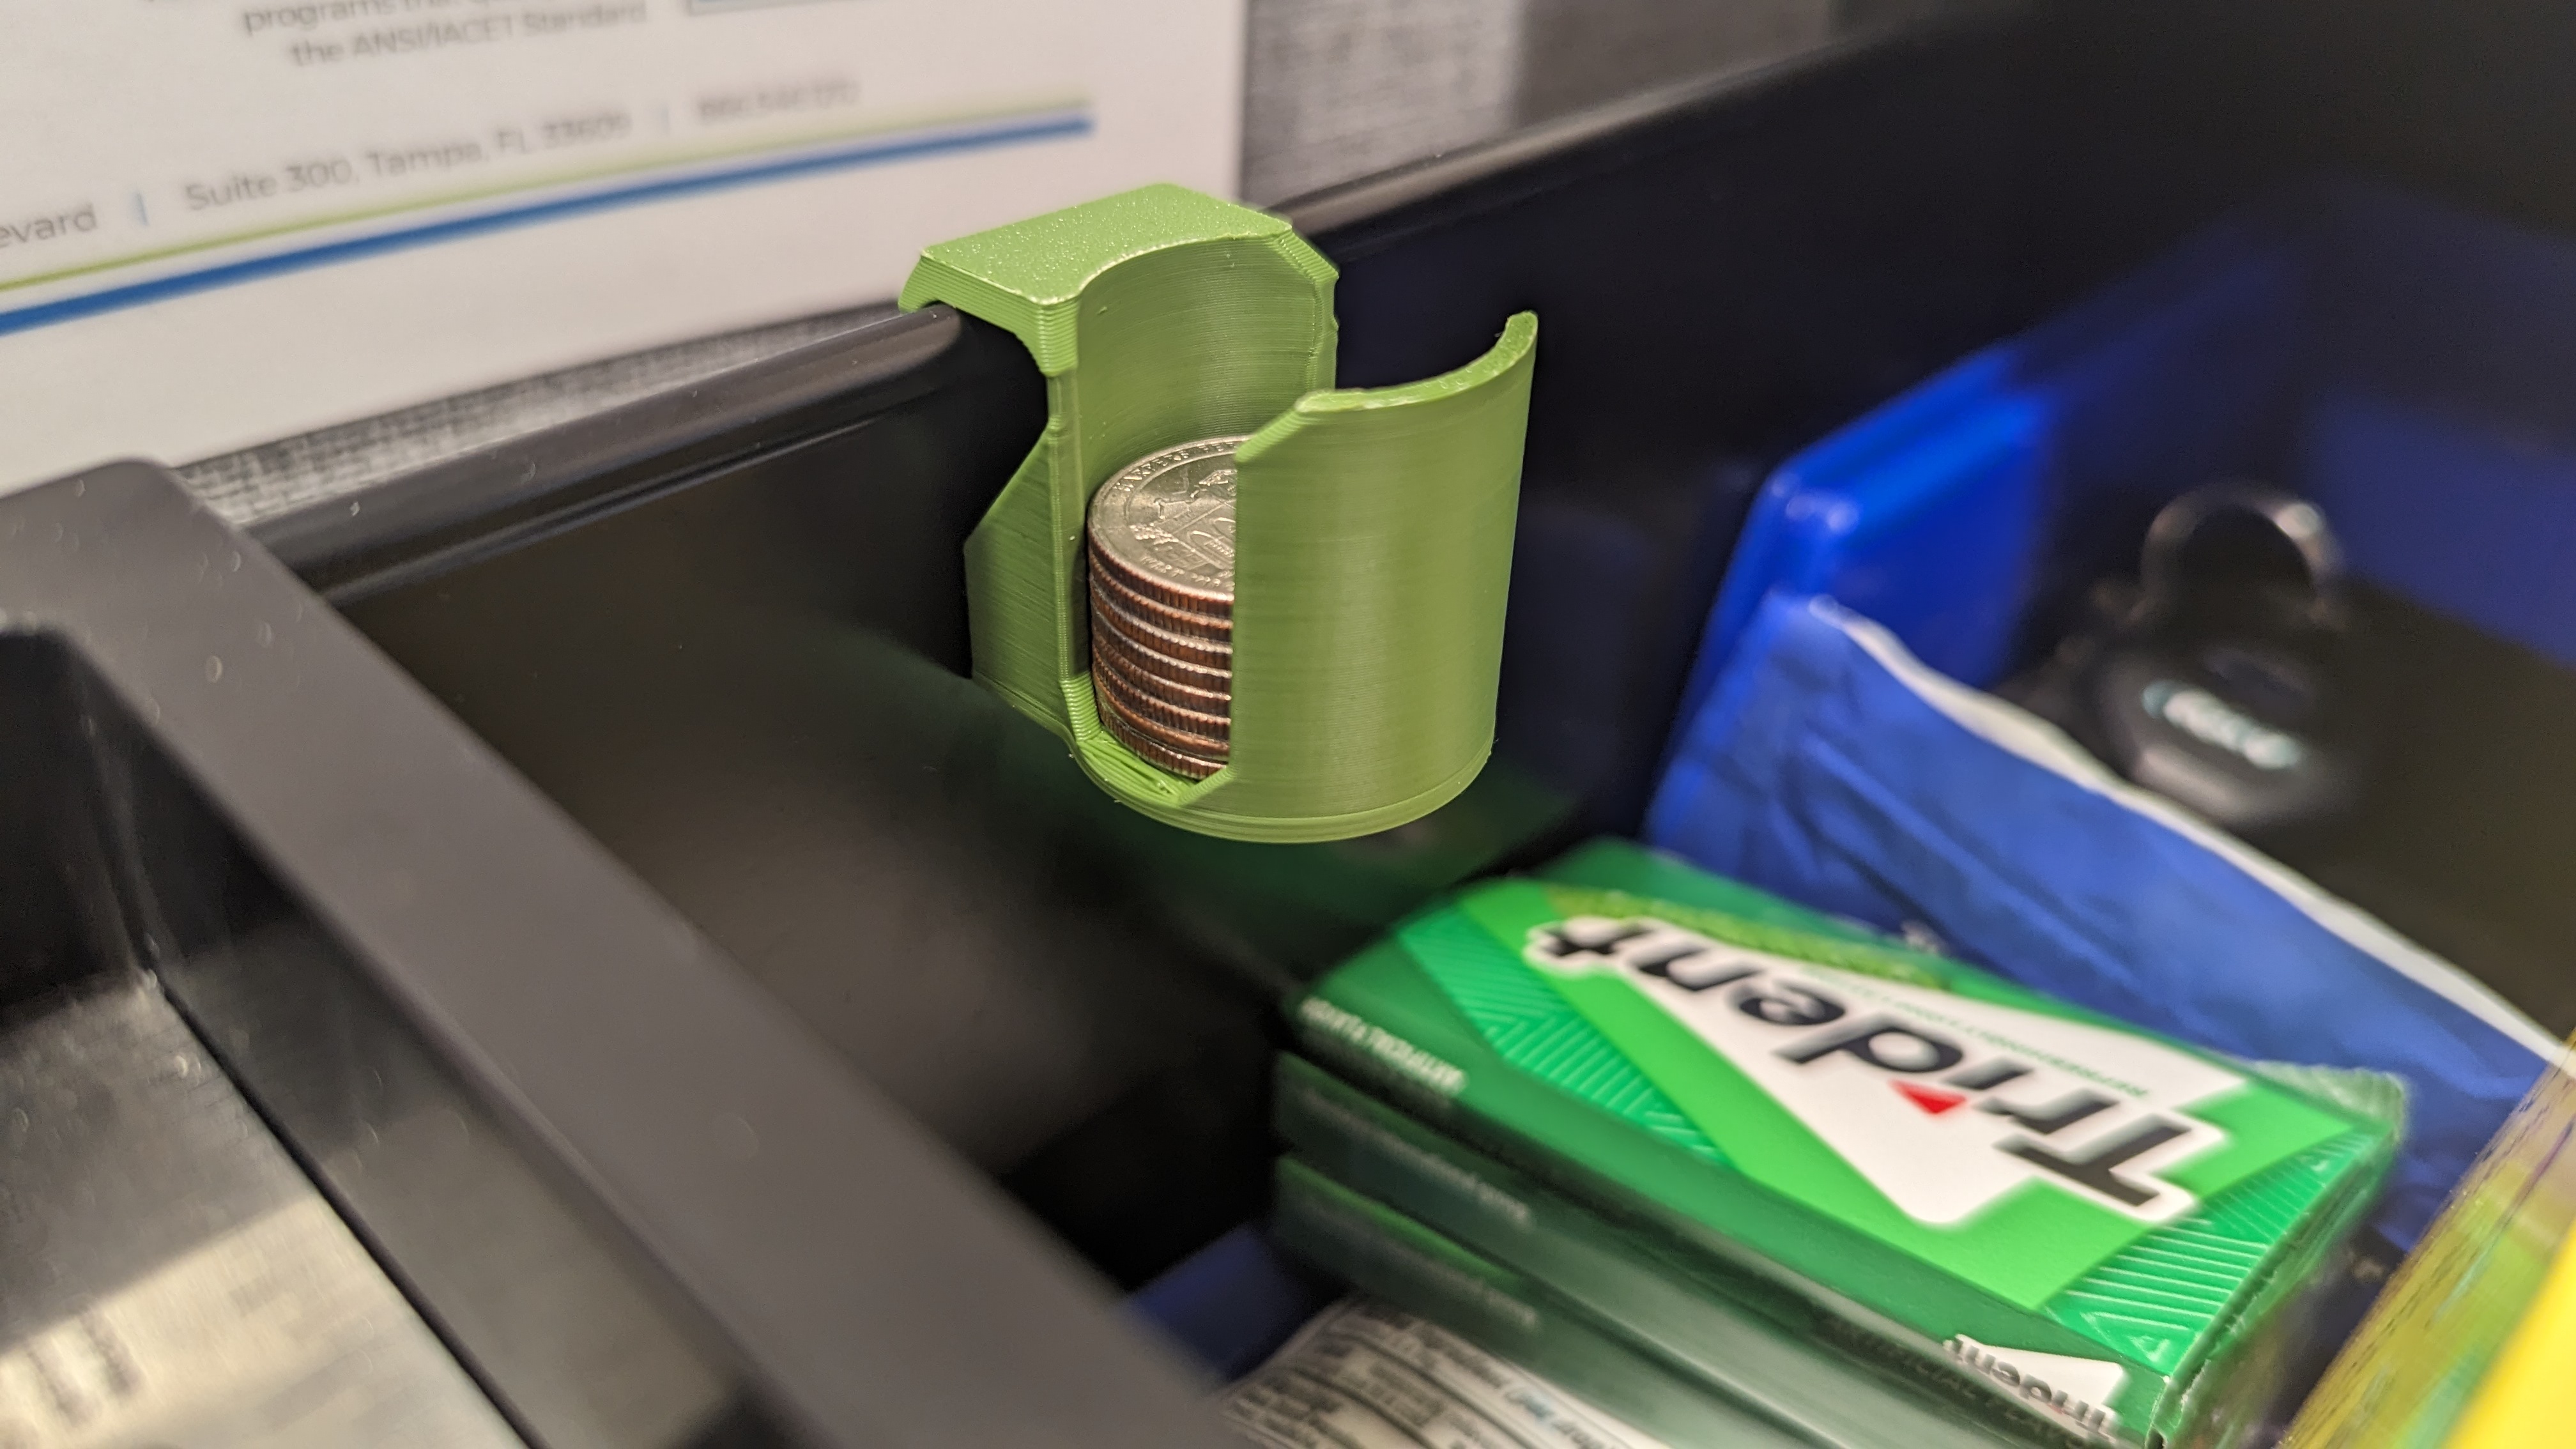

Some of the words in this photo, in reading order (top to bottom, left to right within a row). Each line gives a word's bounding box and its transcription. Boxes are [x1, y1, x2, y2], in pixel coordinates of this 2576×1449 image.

[291, 37, 345, 67] the
[522, 3, 647, 36] Standard
[185, 172, 277, 211] Suite
[286, 158, 360, 189] 300,
[369, 142, 489, 178] Tampa,
[497, 128, 528, 155] FL
[1540, 917, 2193, 1207] Trident
[1951, 1337, 2116, 1444] Trident
